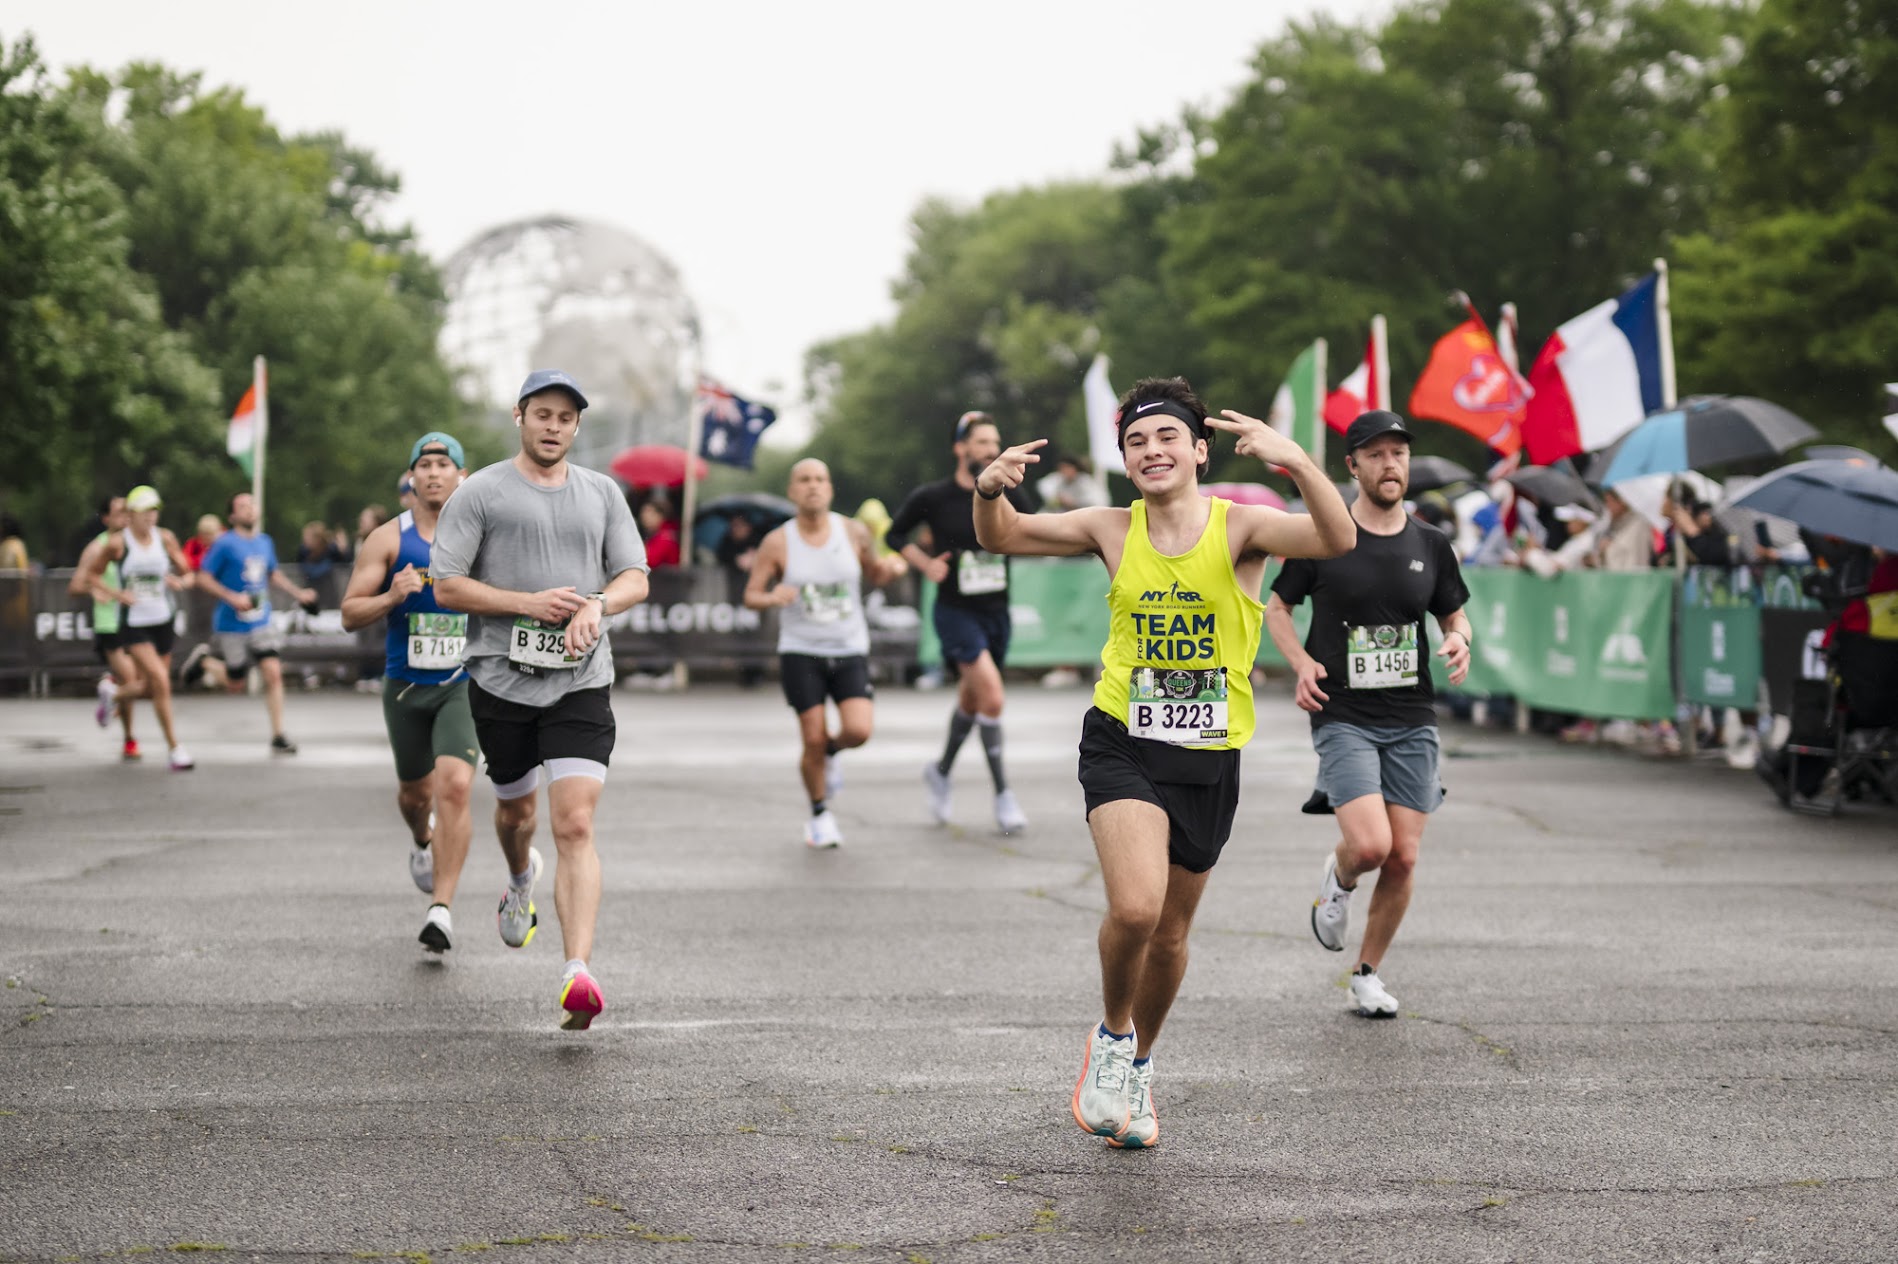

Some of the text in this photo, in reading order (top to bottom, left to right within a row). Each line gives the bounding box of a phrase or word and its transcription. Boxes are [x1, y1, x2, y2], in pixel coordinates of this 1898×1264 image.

[1131, 613, 1215, 636] TEAM
[414, 638, 462, 656] B 7181
[517, 630, 566, 654] B 329
[1146, 637, 1215, 661] KIDS
[1355, 652, 1409, 673] B 1456
[1168, 678, 1192, 687] QUEENS
[1138, 703, 1214, 729] B 3223
